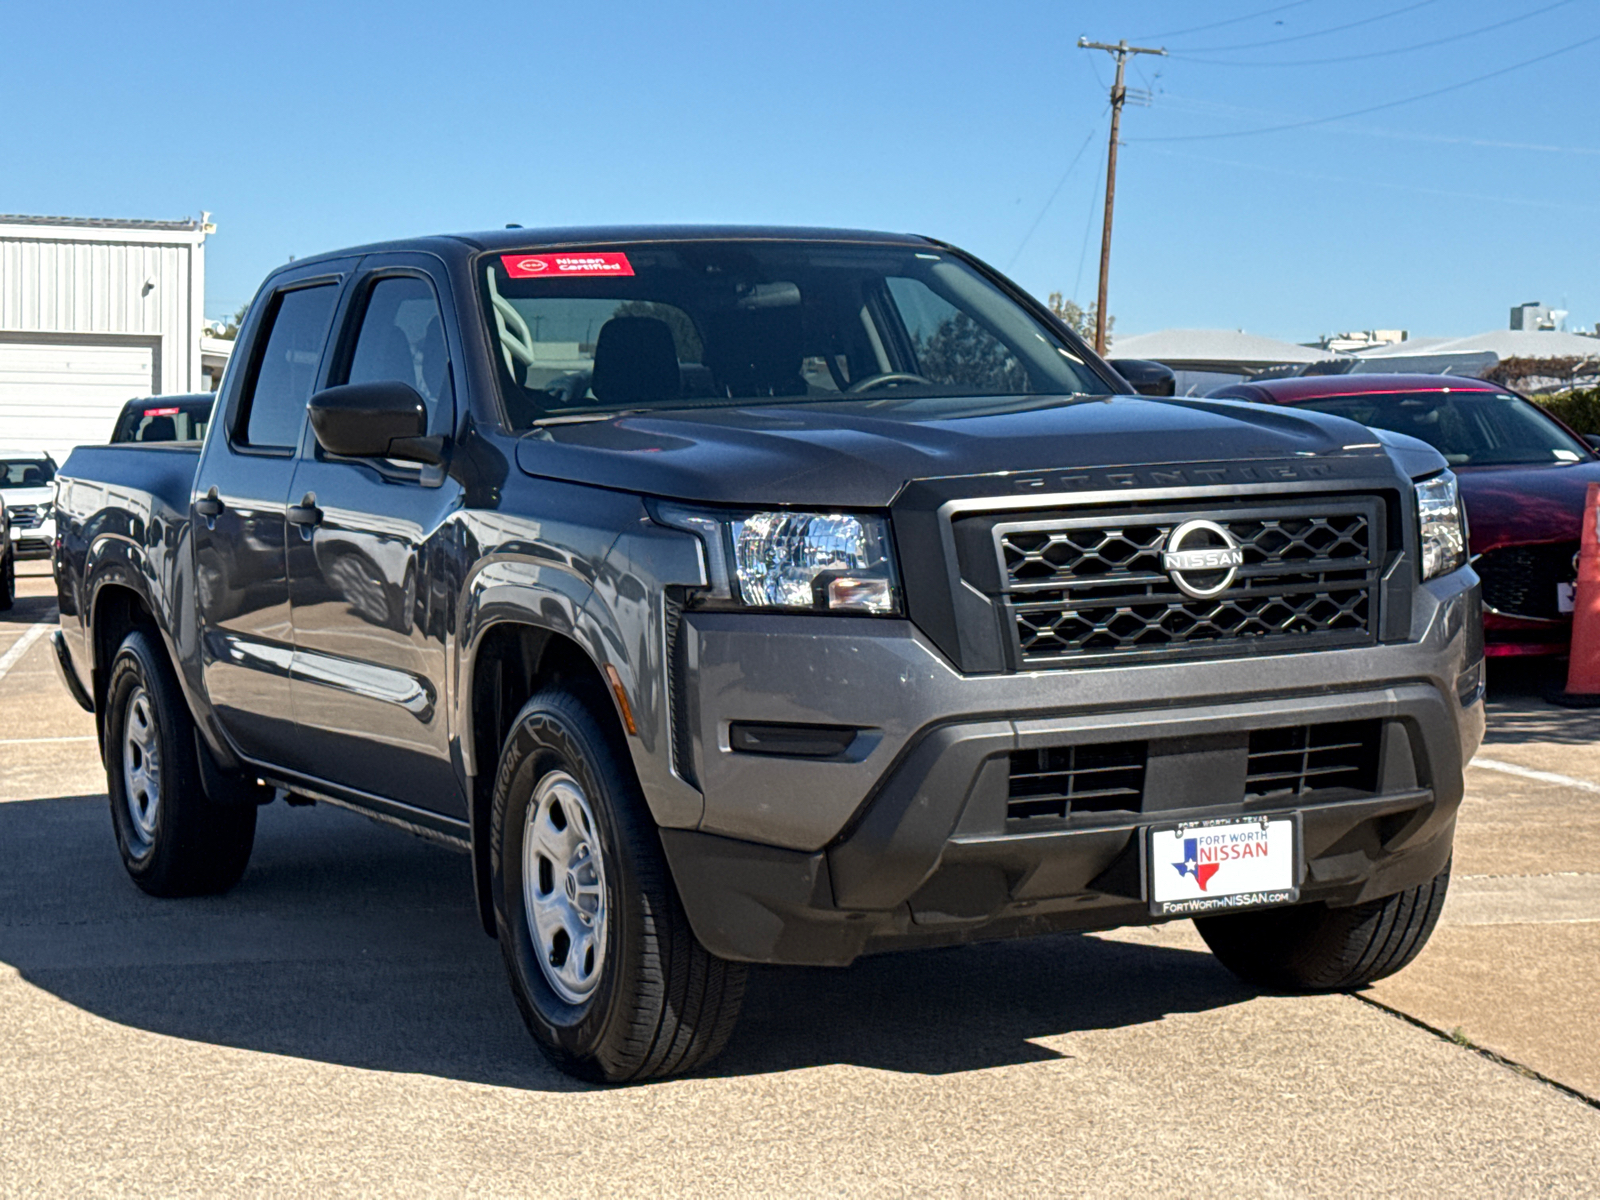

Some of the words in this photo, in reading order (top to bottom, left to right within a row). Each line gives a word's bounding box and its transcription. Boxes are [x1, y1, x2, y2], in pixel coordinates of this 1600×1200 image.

[558, 263, 622, 271] Certified
[1165, 551, 1243, 568] NISSAN
[1242, 815, 1269, 823] TEXAS
[1199, 834, 1227, 846] FORT
[1229, 830, 1268, 843] WORTH
[1199, 841, 1269, 863] NISSAN
